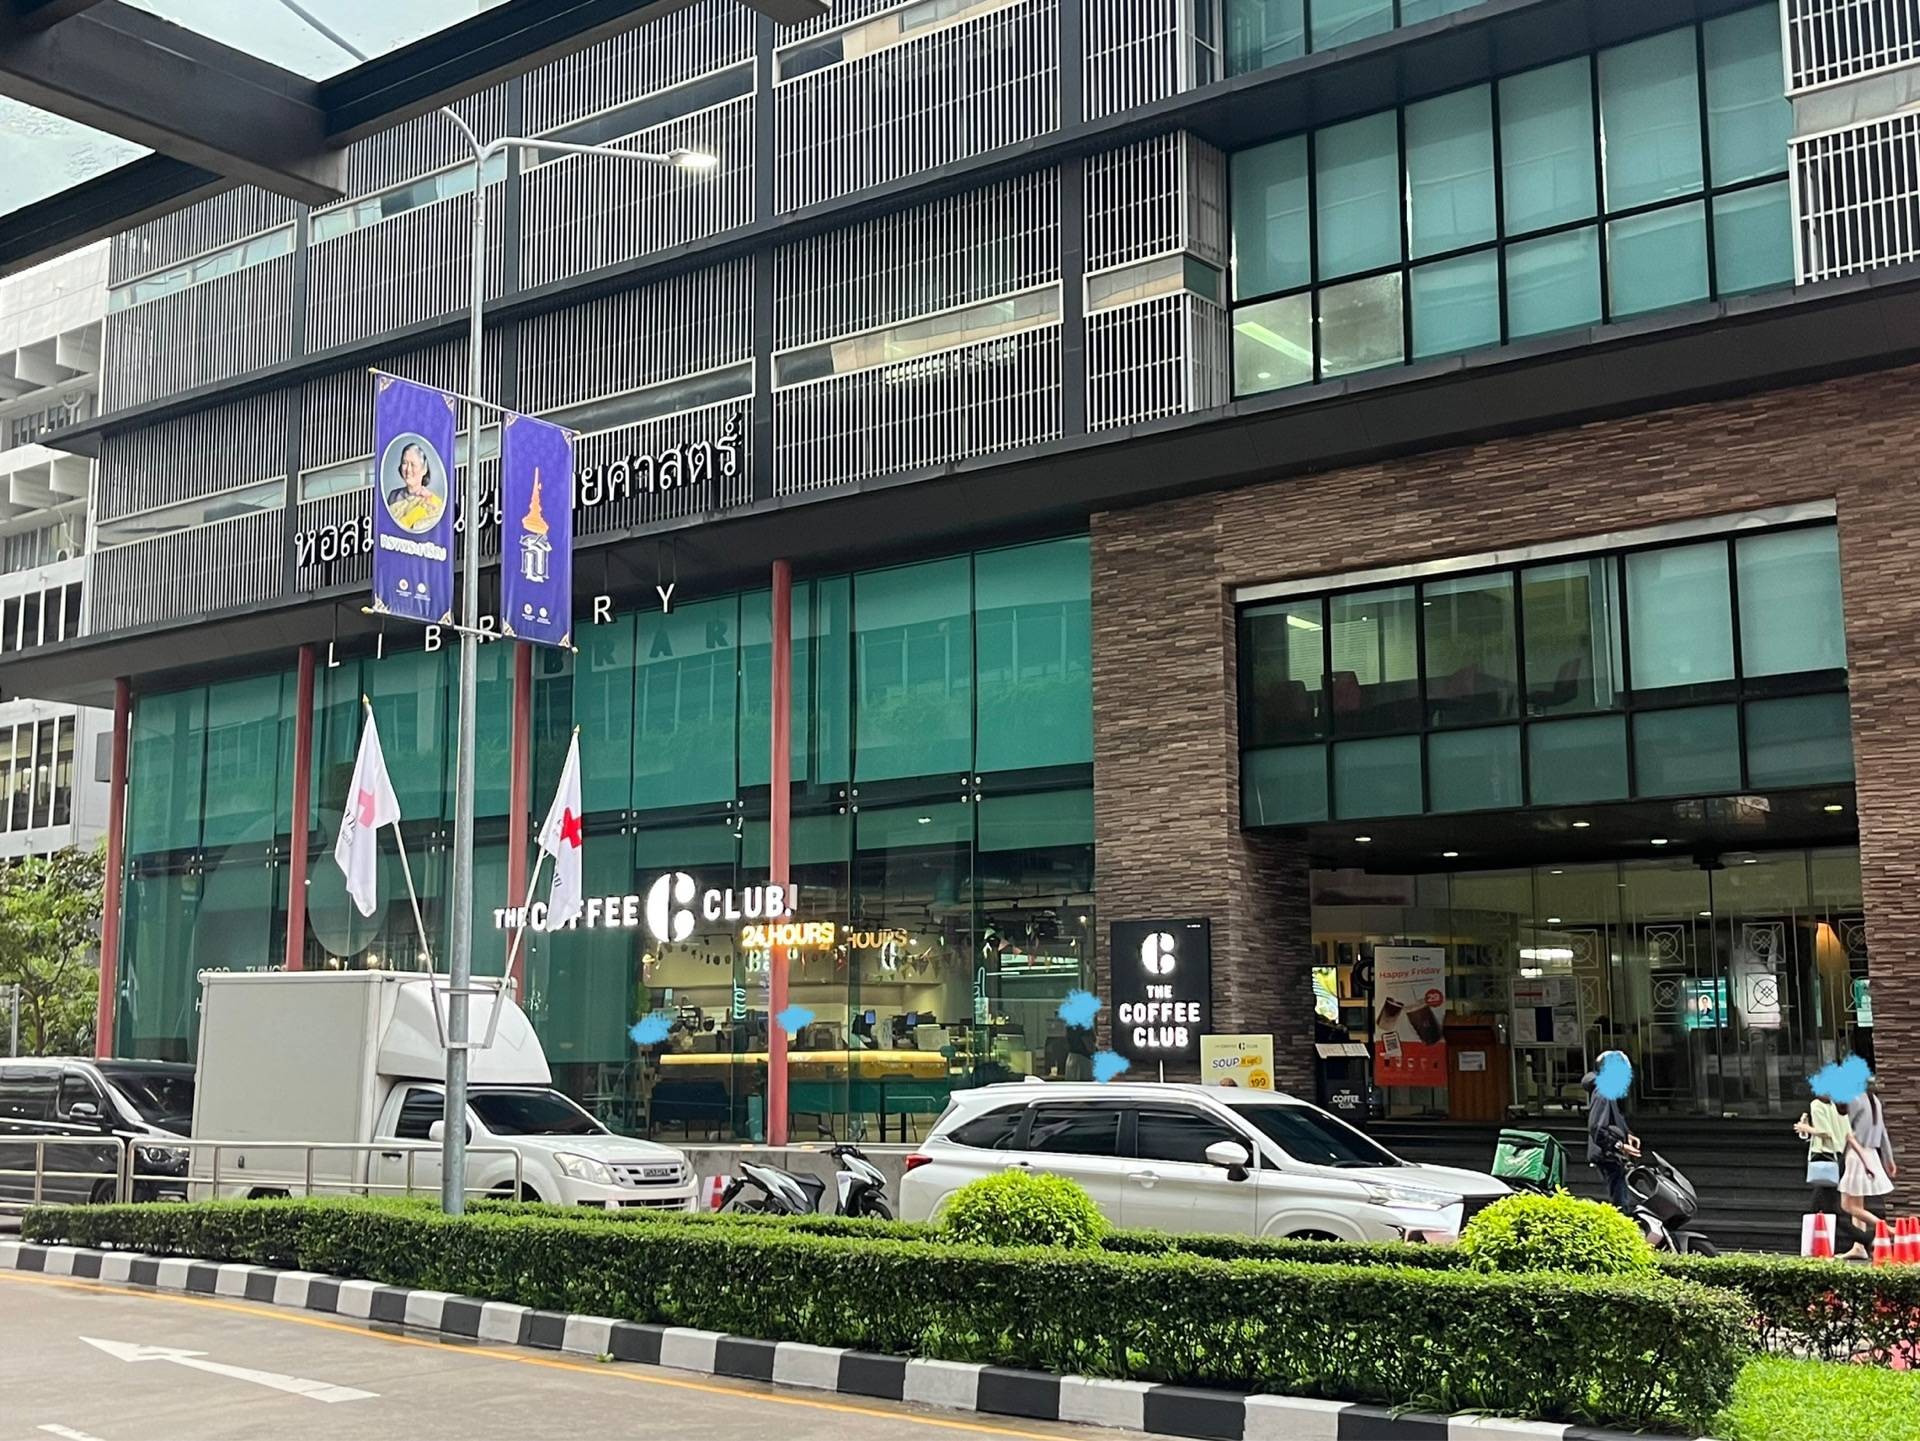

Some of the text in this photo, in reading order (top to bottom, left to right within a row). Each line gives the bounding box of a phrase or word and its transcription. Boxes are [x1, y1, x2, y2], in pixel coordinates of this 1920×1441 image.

[327, 583, 675, 668] LIBRRY
[769, 922, 836, 946] HOURS
[1145, 984, 1173, 999] THE
[1119, 1002, 1201, 1024] COFFEE
[1133, 1026, 1189, 1048] CLUB
[1212, 1057, 1240, 1069] SOUP
[1332, 1094, 1360, 1103] COFFEE
